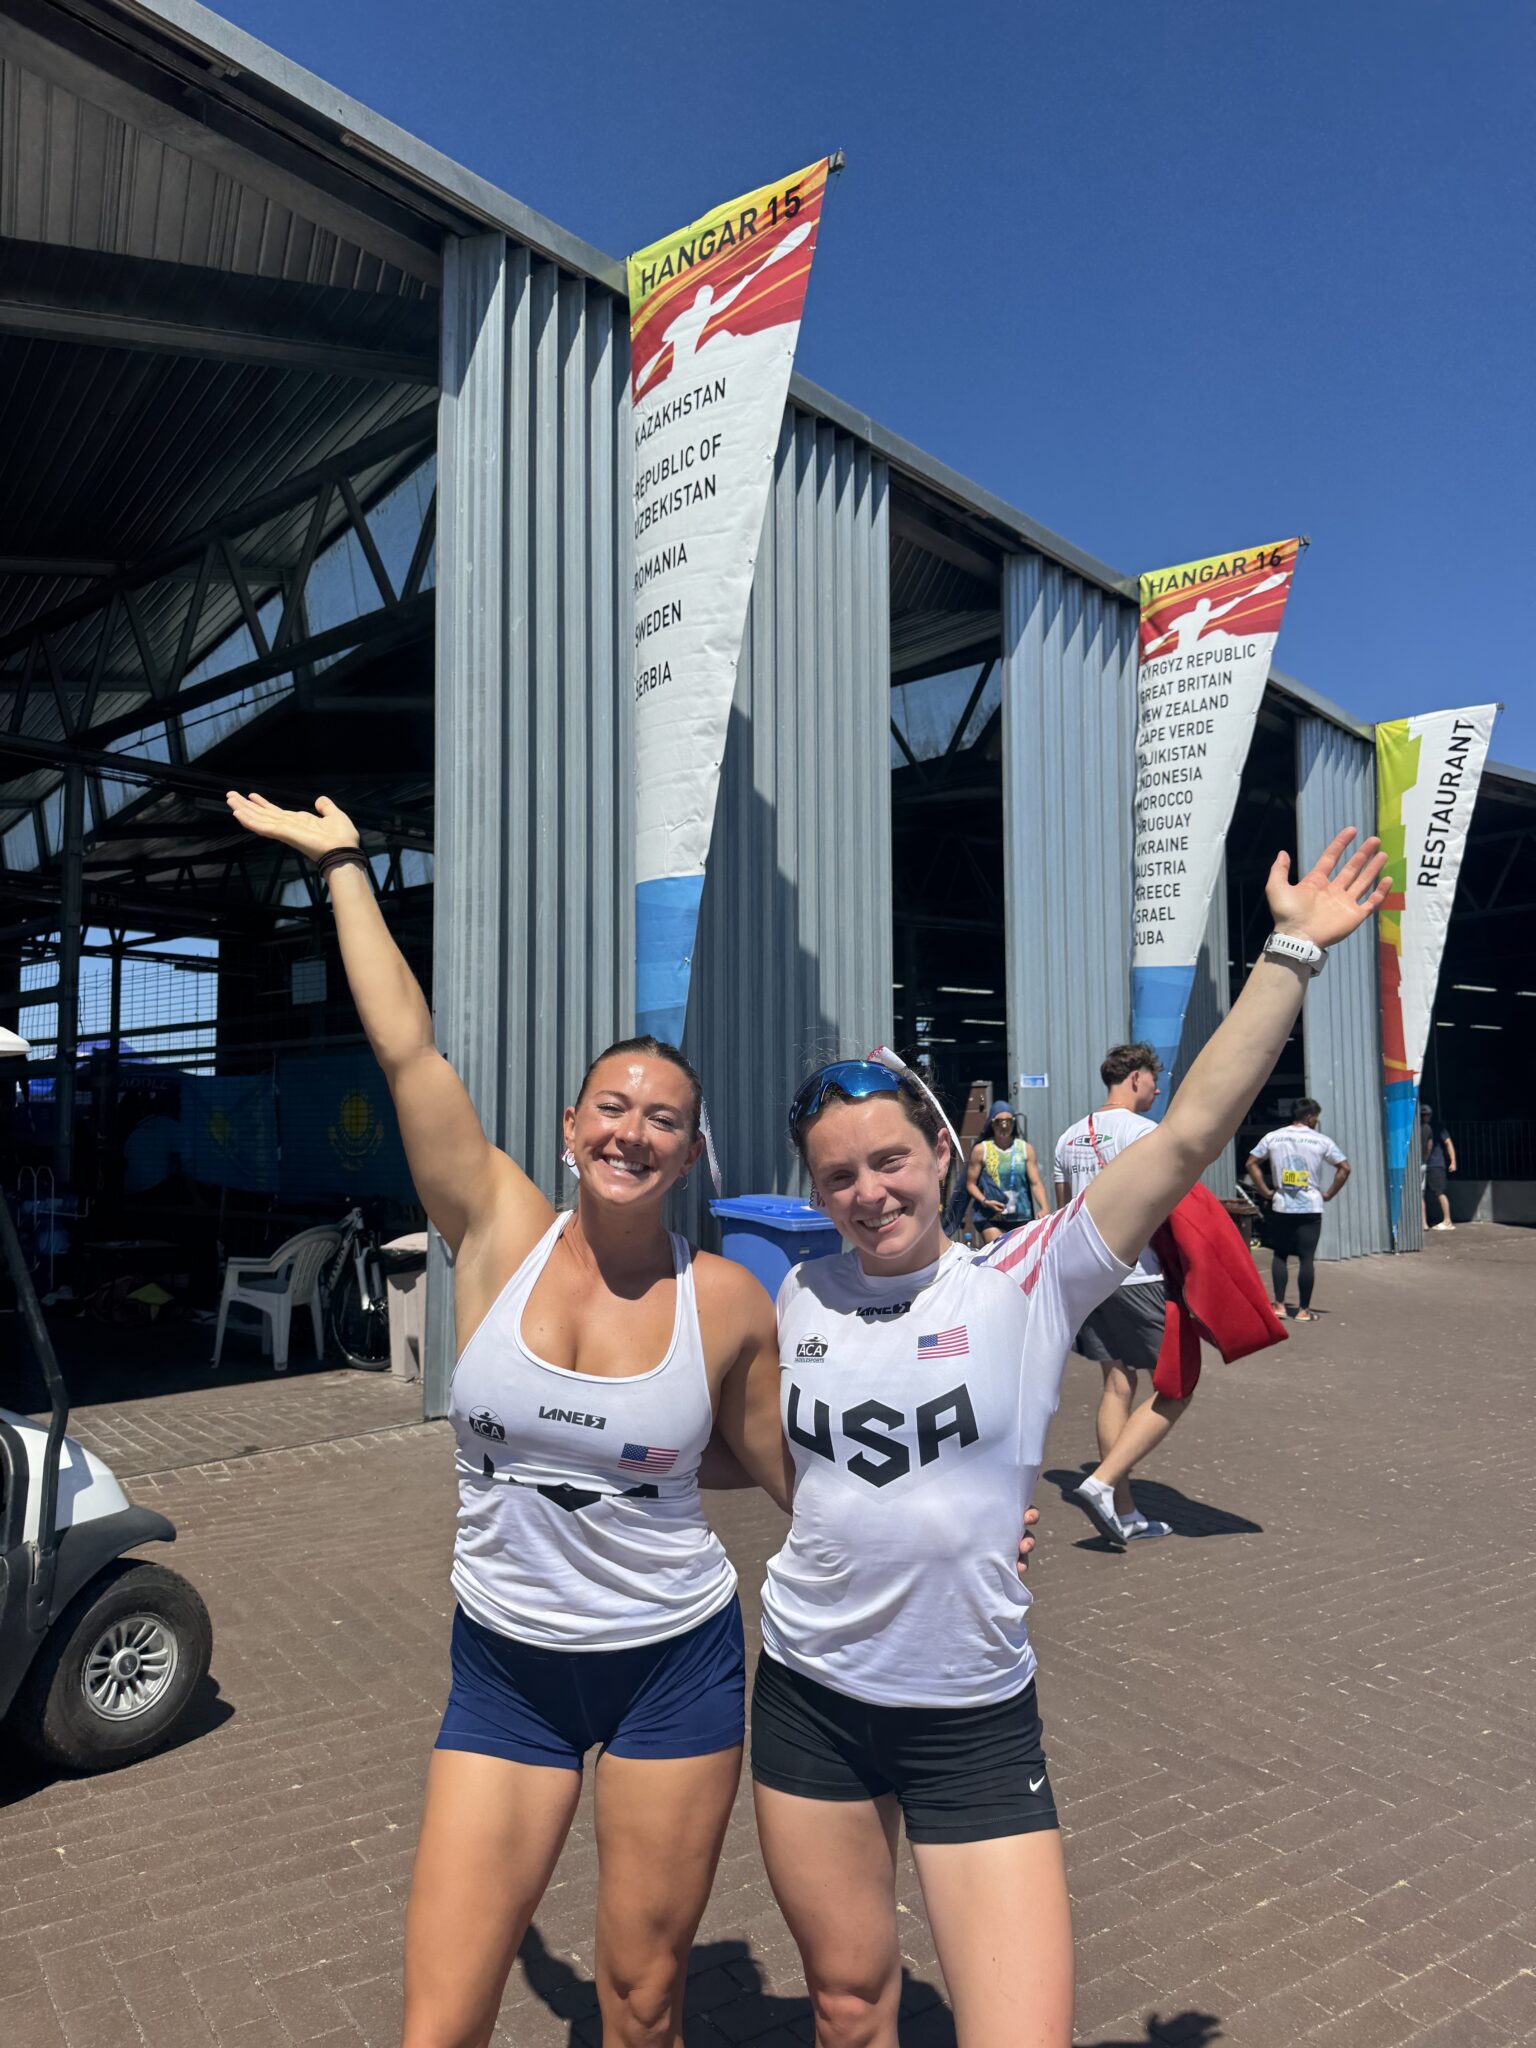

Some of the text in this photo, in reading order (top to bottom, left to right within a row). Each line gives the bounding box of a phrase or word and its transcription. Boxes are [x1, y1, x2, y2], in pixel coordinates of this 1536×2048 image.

[641, 184, 801, 296] HANGAR 15
[635, 378, 726, 452] KAZAKHSTAN
[635, 433, 722, 505] REPUBLIC OF
[634, 474, 716, 540] UZBEKISTAN
[634, 543, 688, 594] ROMANIA
[1150, 548, 1282, 596] HANGAR 16
[635, 600, 682, 648] SWEDEN
[1141, 643, 1257, 683] KYRGYZ REPUBLIC
[635, 661, 672, 702] SERBIA
[1140, 671, 1233, 704] GREAT BRITAIN
[1142, 694, 1229, 725] NEW ZEALAND
[1139, 719, 1214, 748] CAPE VERDE
[1138, 743, 1207, 769] TAJIKISTAN
[1139, 766, 1203, 792] NDONESIA
[1136, 789, 1193, 812] MOROCCO
[1416, 719, 1475, 888] RESTAURANT
[1136, 836, 1189, 857] UKRAINE
[1135, 859, 1187, 878] AUSTRIA
[1135, 883, 1181, 902] GREECE
[1136, 906, 1176, 923] SRAEL
[797, 1344, 823, 1356] ACA
[473, 1419, 502, 1439] ACA
[787, 1382, 980, 1488] USA
